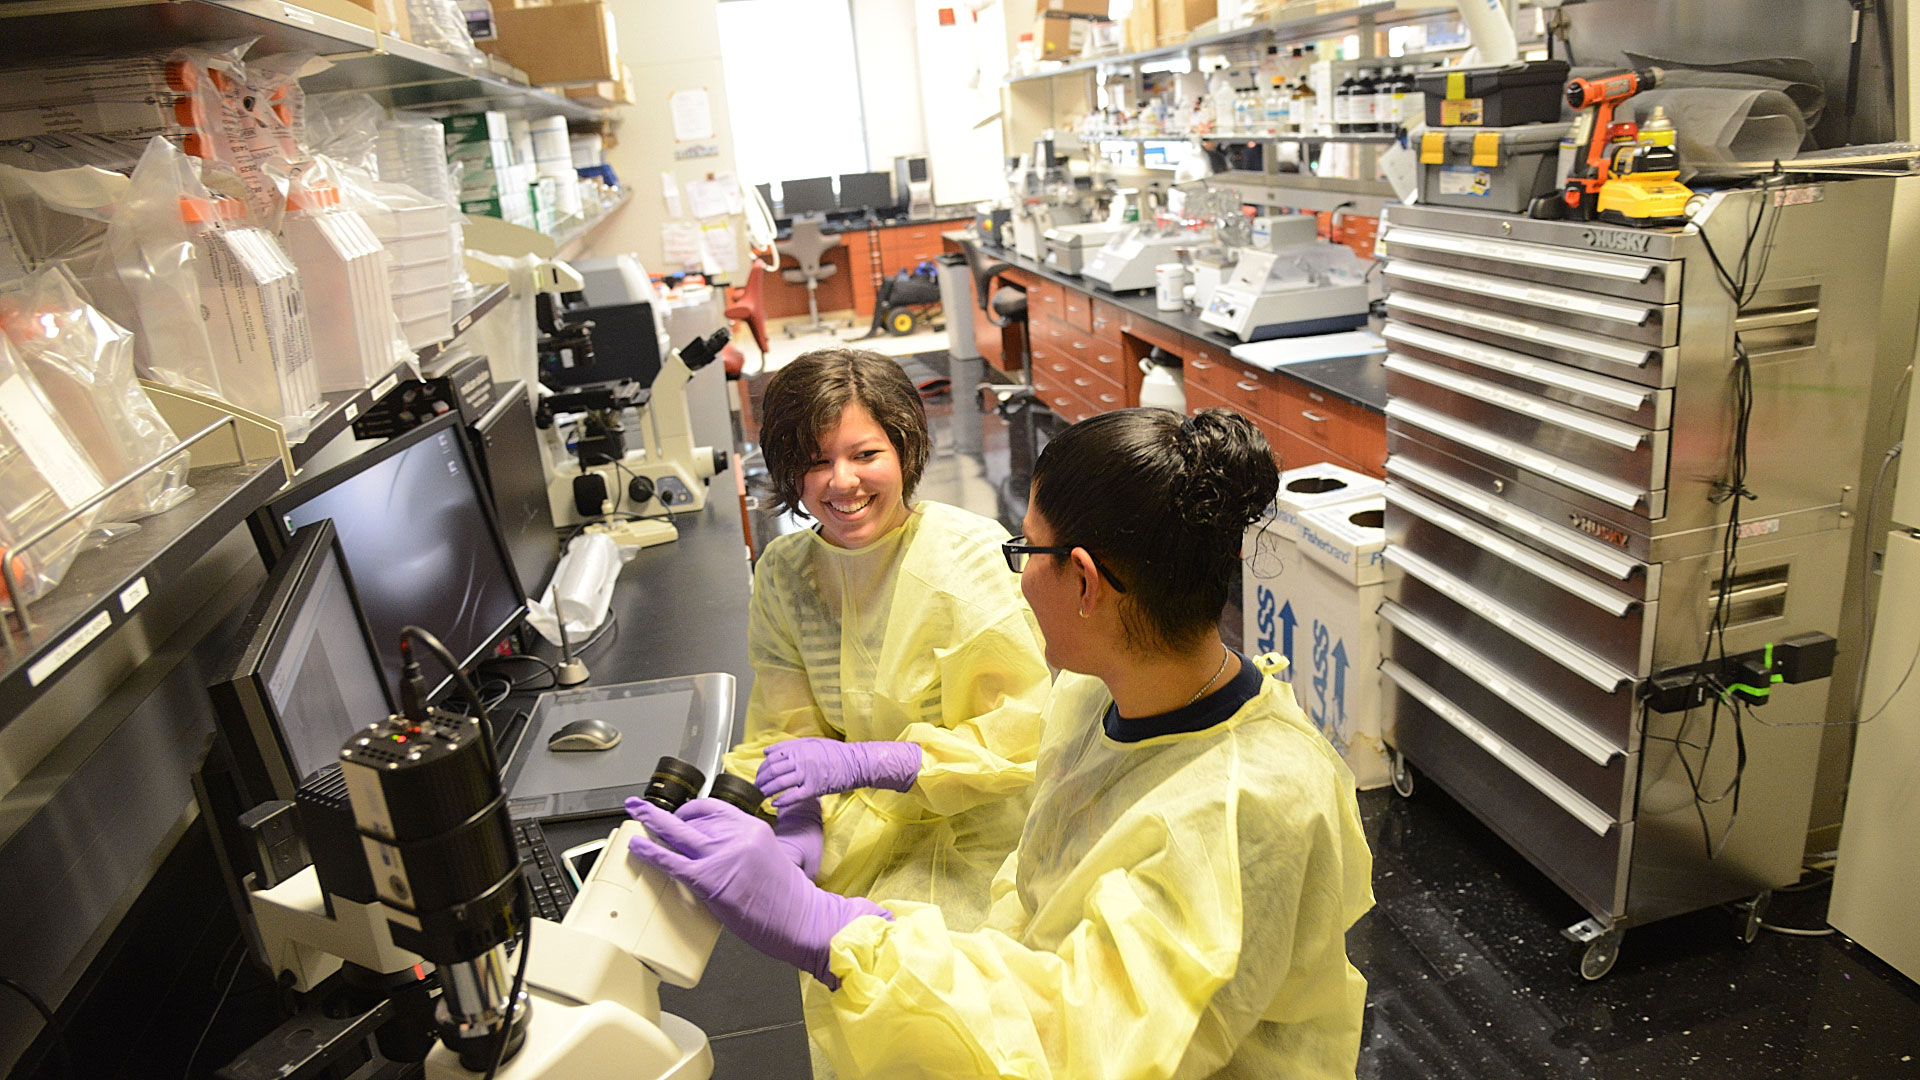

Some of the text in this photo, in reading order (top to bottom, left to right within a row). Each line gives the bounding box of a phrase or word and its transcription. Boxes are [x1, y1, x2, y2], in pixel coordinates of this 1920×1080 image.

[1595, 230, 1651, 253] HUSKY
[1302, 526, 1350, 564] Fisherbrand
[1581, 516, 1630, 548] HUSKY
[1257, 585, 1276, 654] ASS
[1311, 619, 1330, 730] LASS
